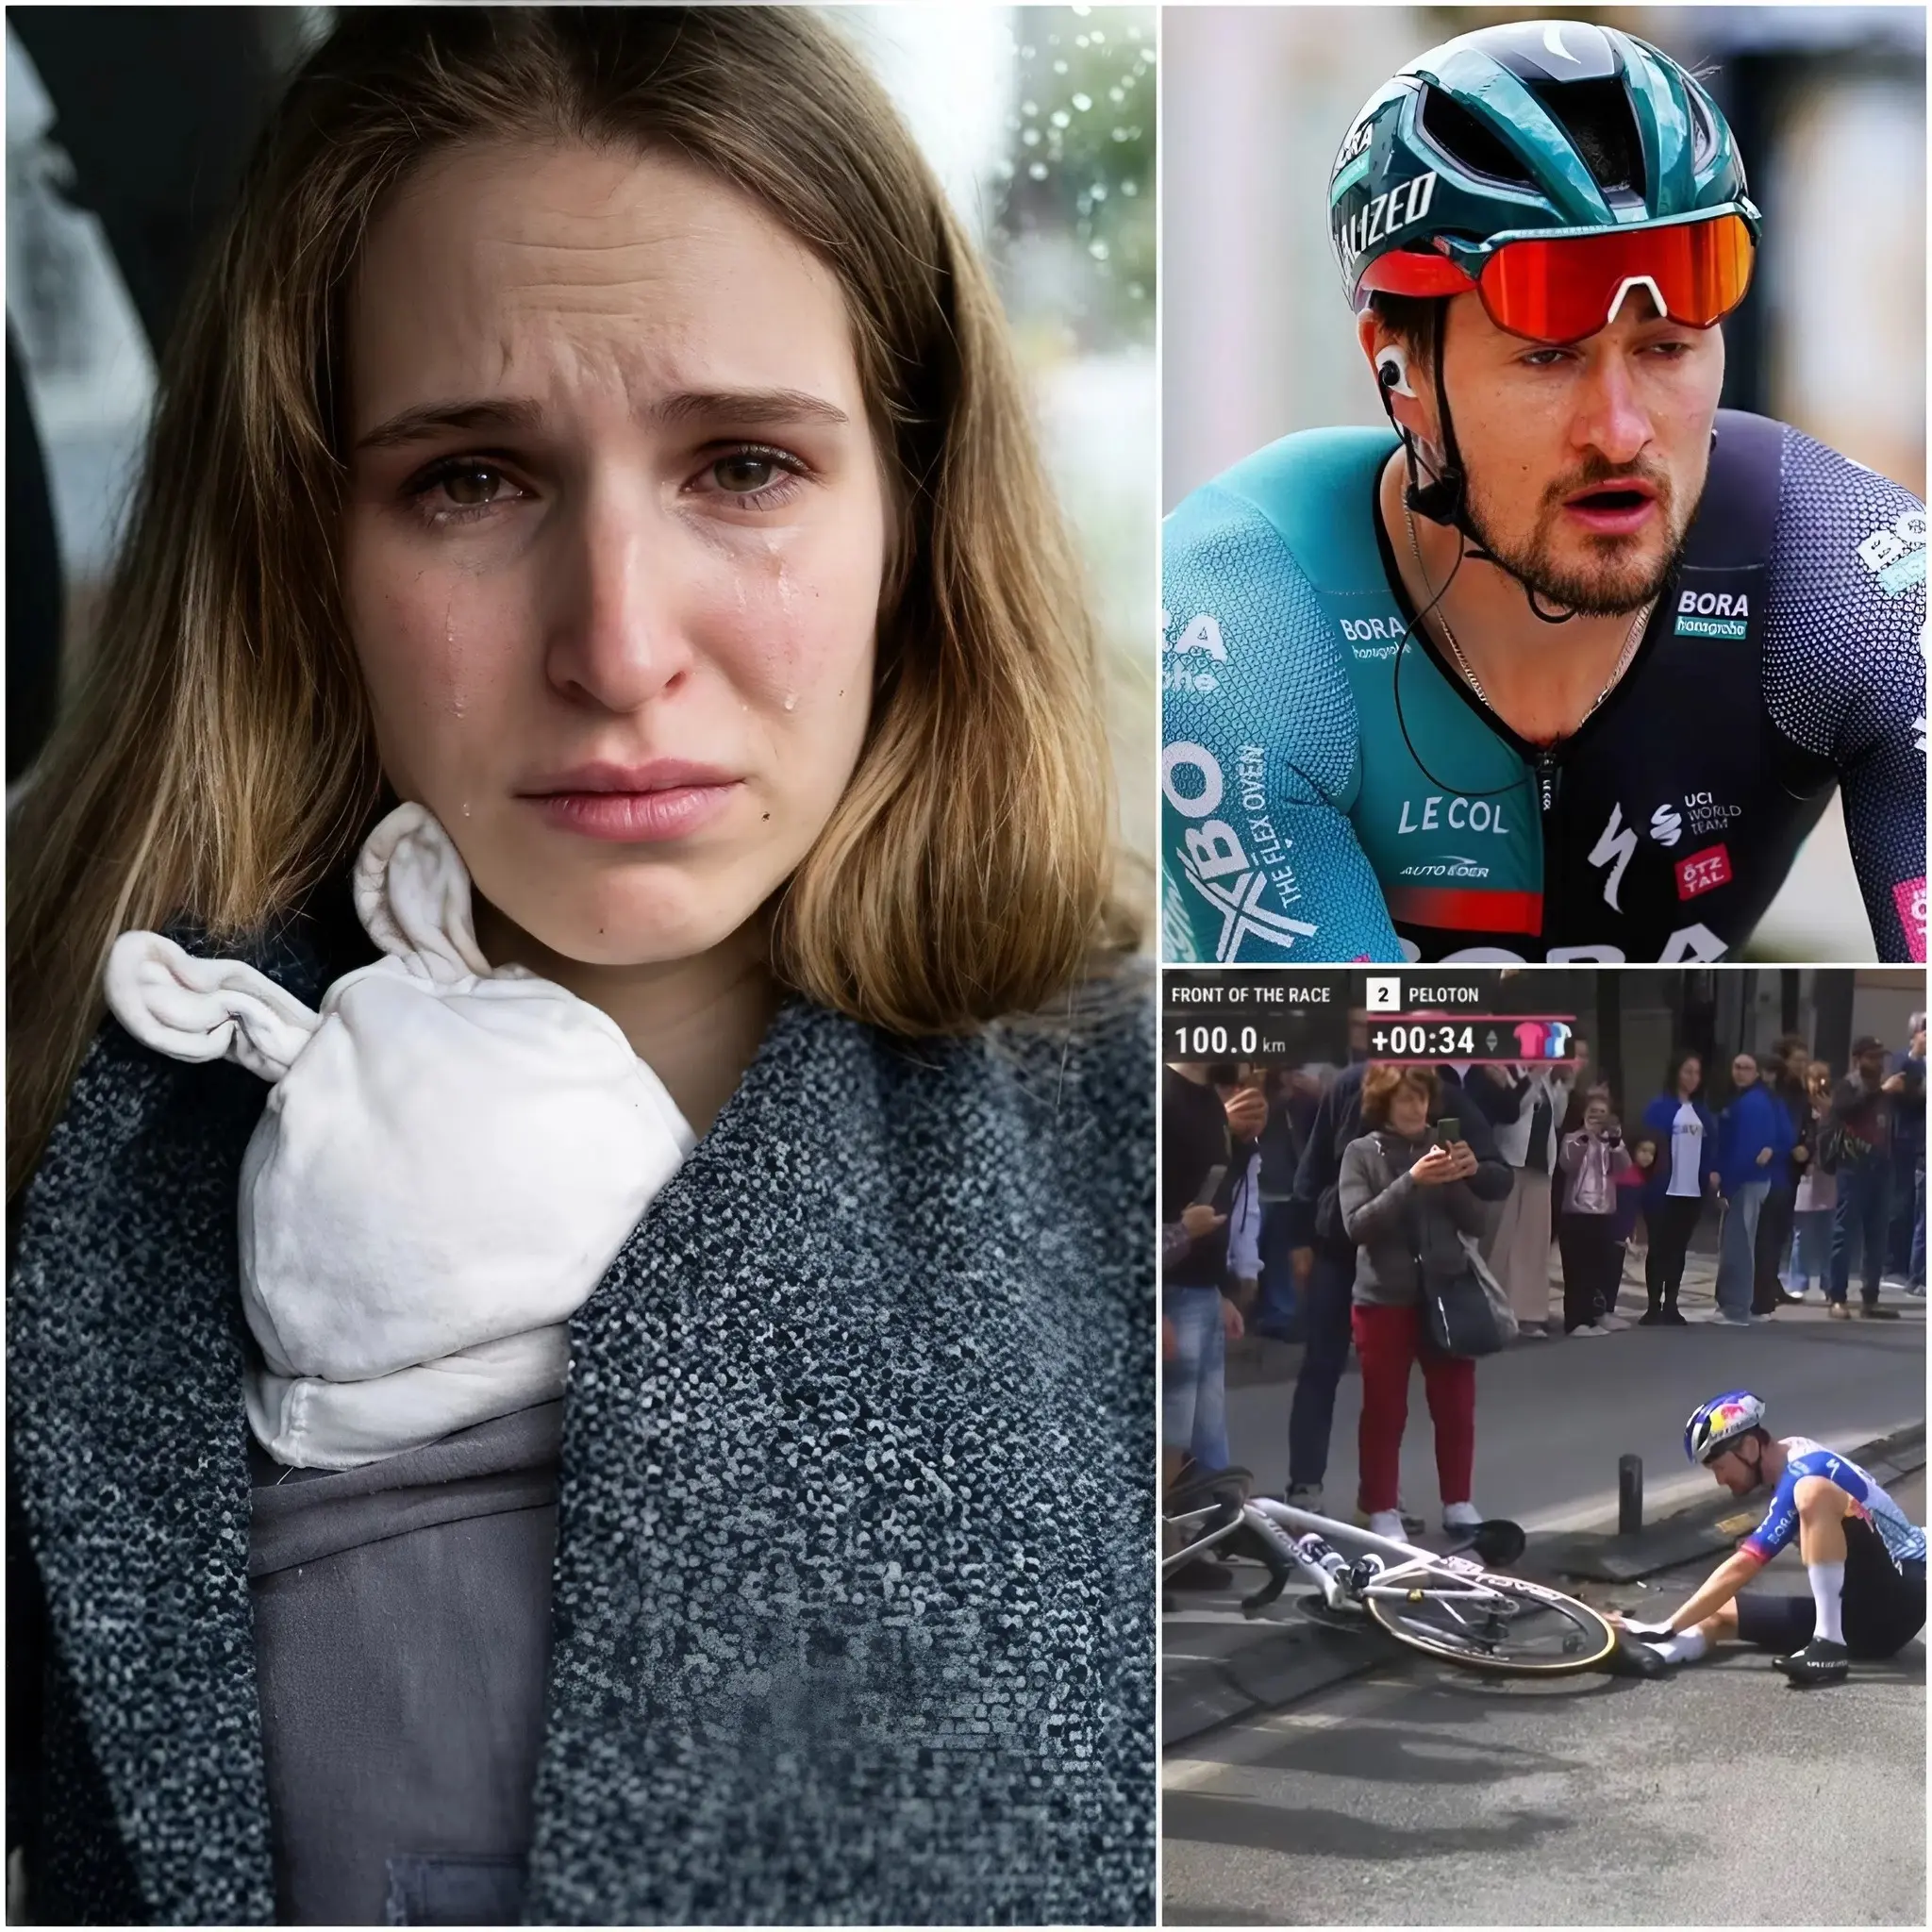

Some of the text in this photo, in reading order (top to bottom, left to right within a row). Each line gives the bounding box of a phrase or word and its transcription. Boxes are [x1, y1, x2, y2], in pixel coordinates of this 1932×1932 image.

[1677, 590, 1749, 617] BORA
[1340, 616, 1406, 641] BORA
[1684, 791, 1713, 807] UCI
[1398, 796, 1509, 834] LE COL
[1688, 805, 1741, 821] WORLD
[1235, 744, 1302, 909] THE FLEX OVEN
[1690, 818, 1728, 835] TEAM
[1684, 856, 1723, 882] ÖTZ
[1685, 871, 1724, 892] TAL
